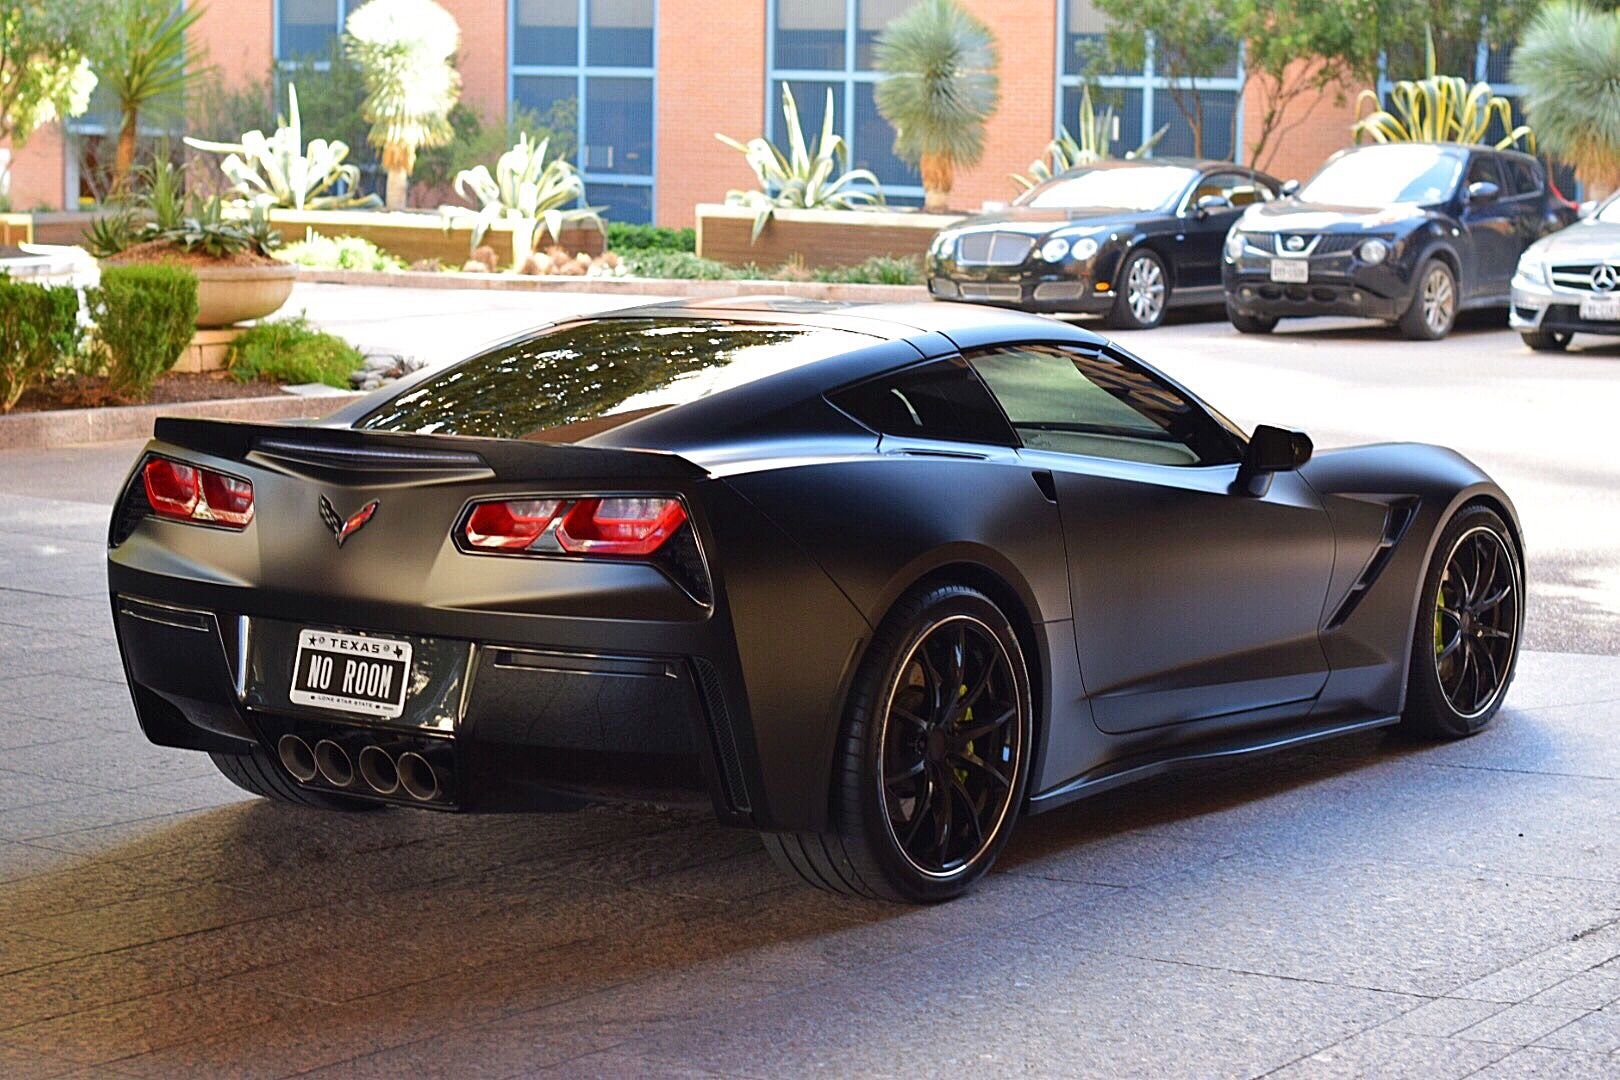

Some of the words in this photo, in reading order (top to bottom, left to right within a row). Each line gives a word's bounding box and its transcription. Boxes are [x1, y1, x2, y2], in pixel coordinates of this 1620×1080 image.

[330, 638, 380, 653] TEXAS
[307, 654, 333, 690] NO
[342, 659, 394, 699] ROOM
[354, 700, 373, 708] STATE
